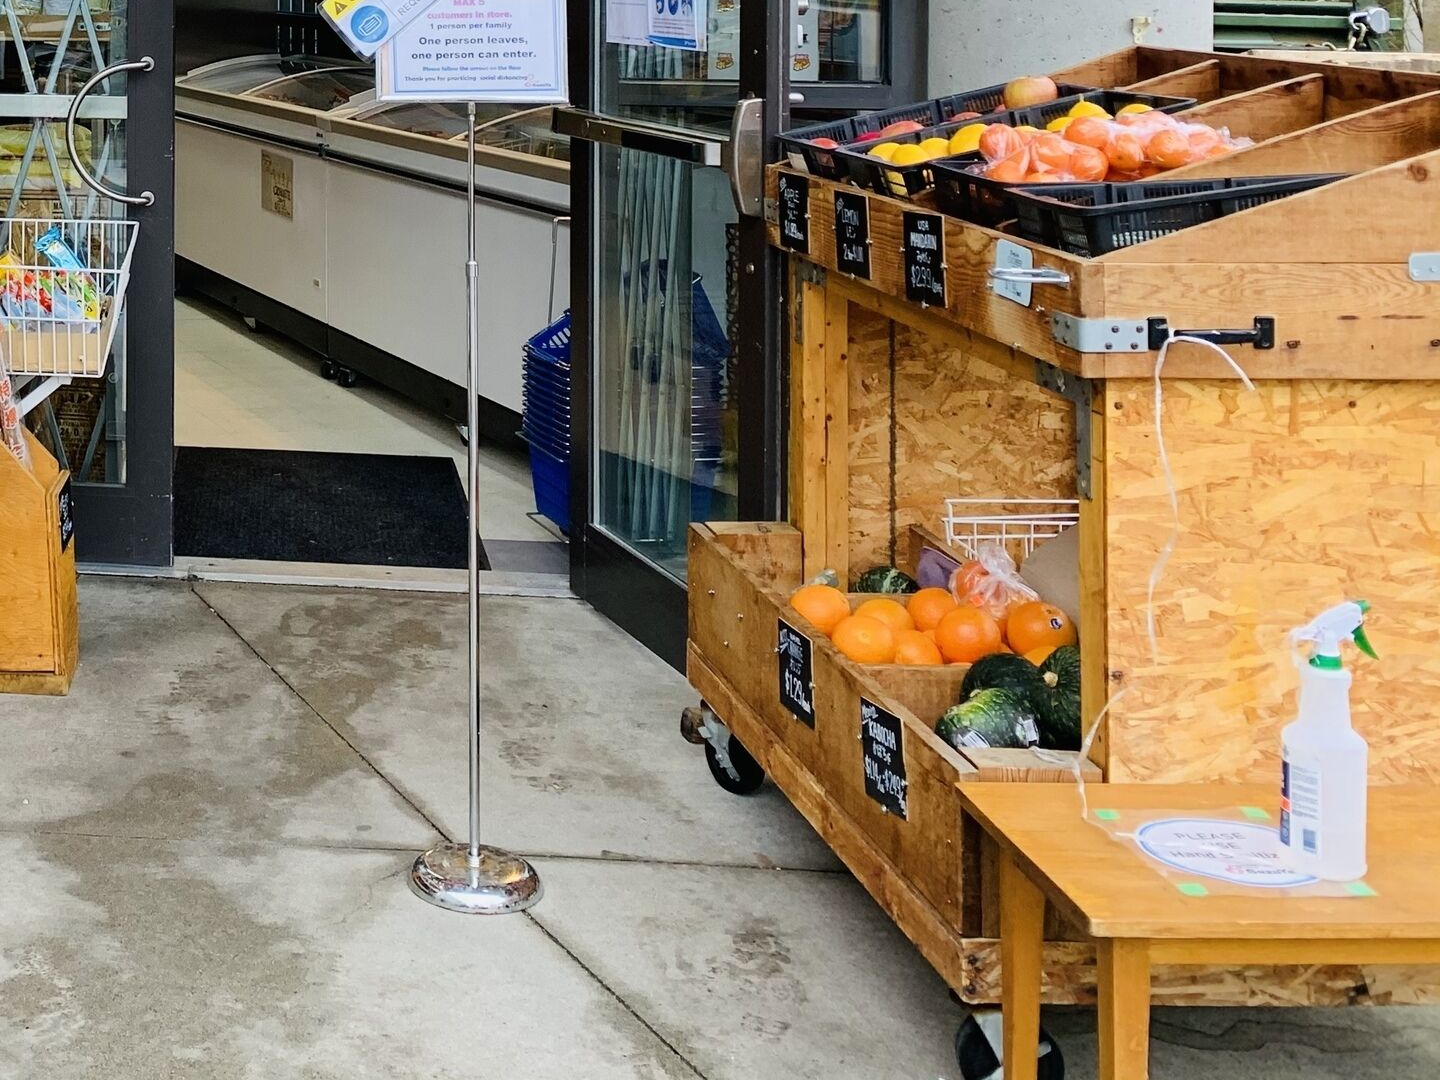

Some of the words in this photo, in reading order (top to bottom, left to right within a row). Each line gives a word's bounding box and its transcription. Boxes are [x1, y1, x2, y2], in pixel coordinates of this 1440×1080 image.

[453, 0, 476, 7] MAX
[427, 12, 473, 20] customers
[475, 11, 484, 19] in
[485, 22, 513, 30] family
[419, 37, 441, 45] One
[445, 37, 484, 46] person
[487, 36, 529, 45] leaves,
[411, 52, 432, 60] one
[435, 52, 475, 61] person
[478, 51, 499, 59] can
[502, 50, 537, 58] enter.
[1173, 832, 1247, 841] PLEASE
[1169, 851, 1217, 859] Hand
